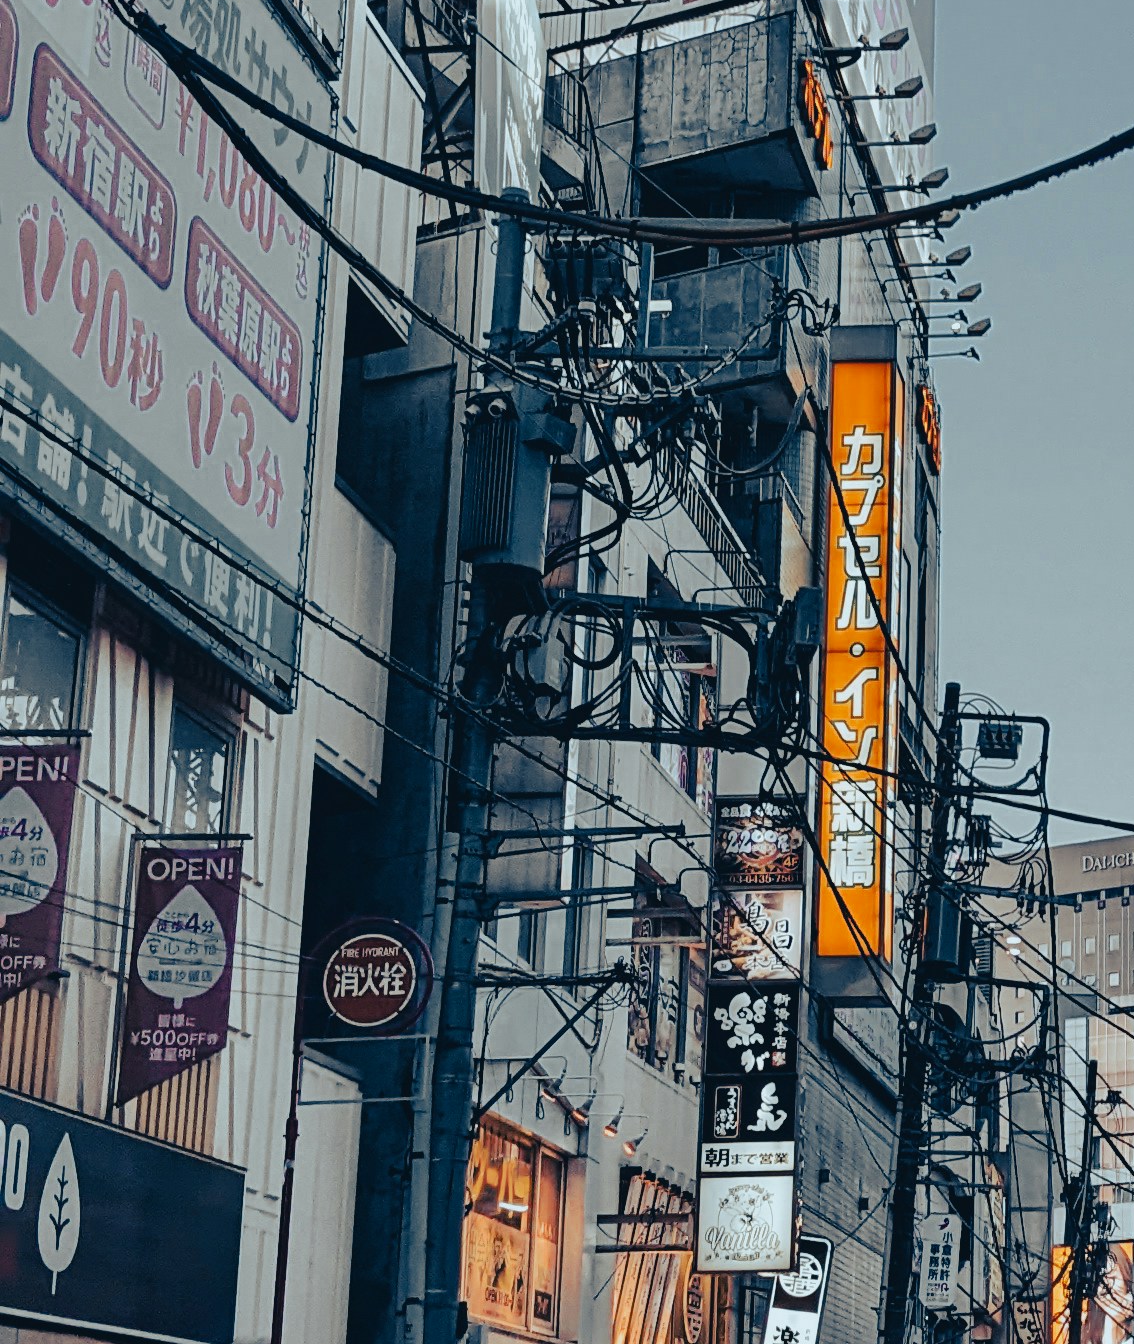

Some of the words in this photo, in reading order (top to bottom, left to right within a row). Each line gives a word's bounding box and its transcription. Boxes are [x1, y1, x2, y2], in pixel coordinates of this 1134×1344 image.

[43, 76, 164, 262] 新宿駅より
[71, 237, 165, 411] 90秒
[196, 242, 293, 399] 秋葉原駅より
[224, 393, 285, 529] 3分
[147, 857, 235, 881] OPEN!
[333, 962, 407, 998] 消火栓
[704, 1147, 789, 1168] 朝まで営業
[704, 1223, 780, 1253] Vanilla
